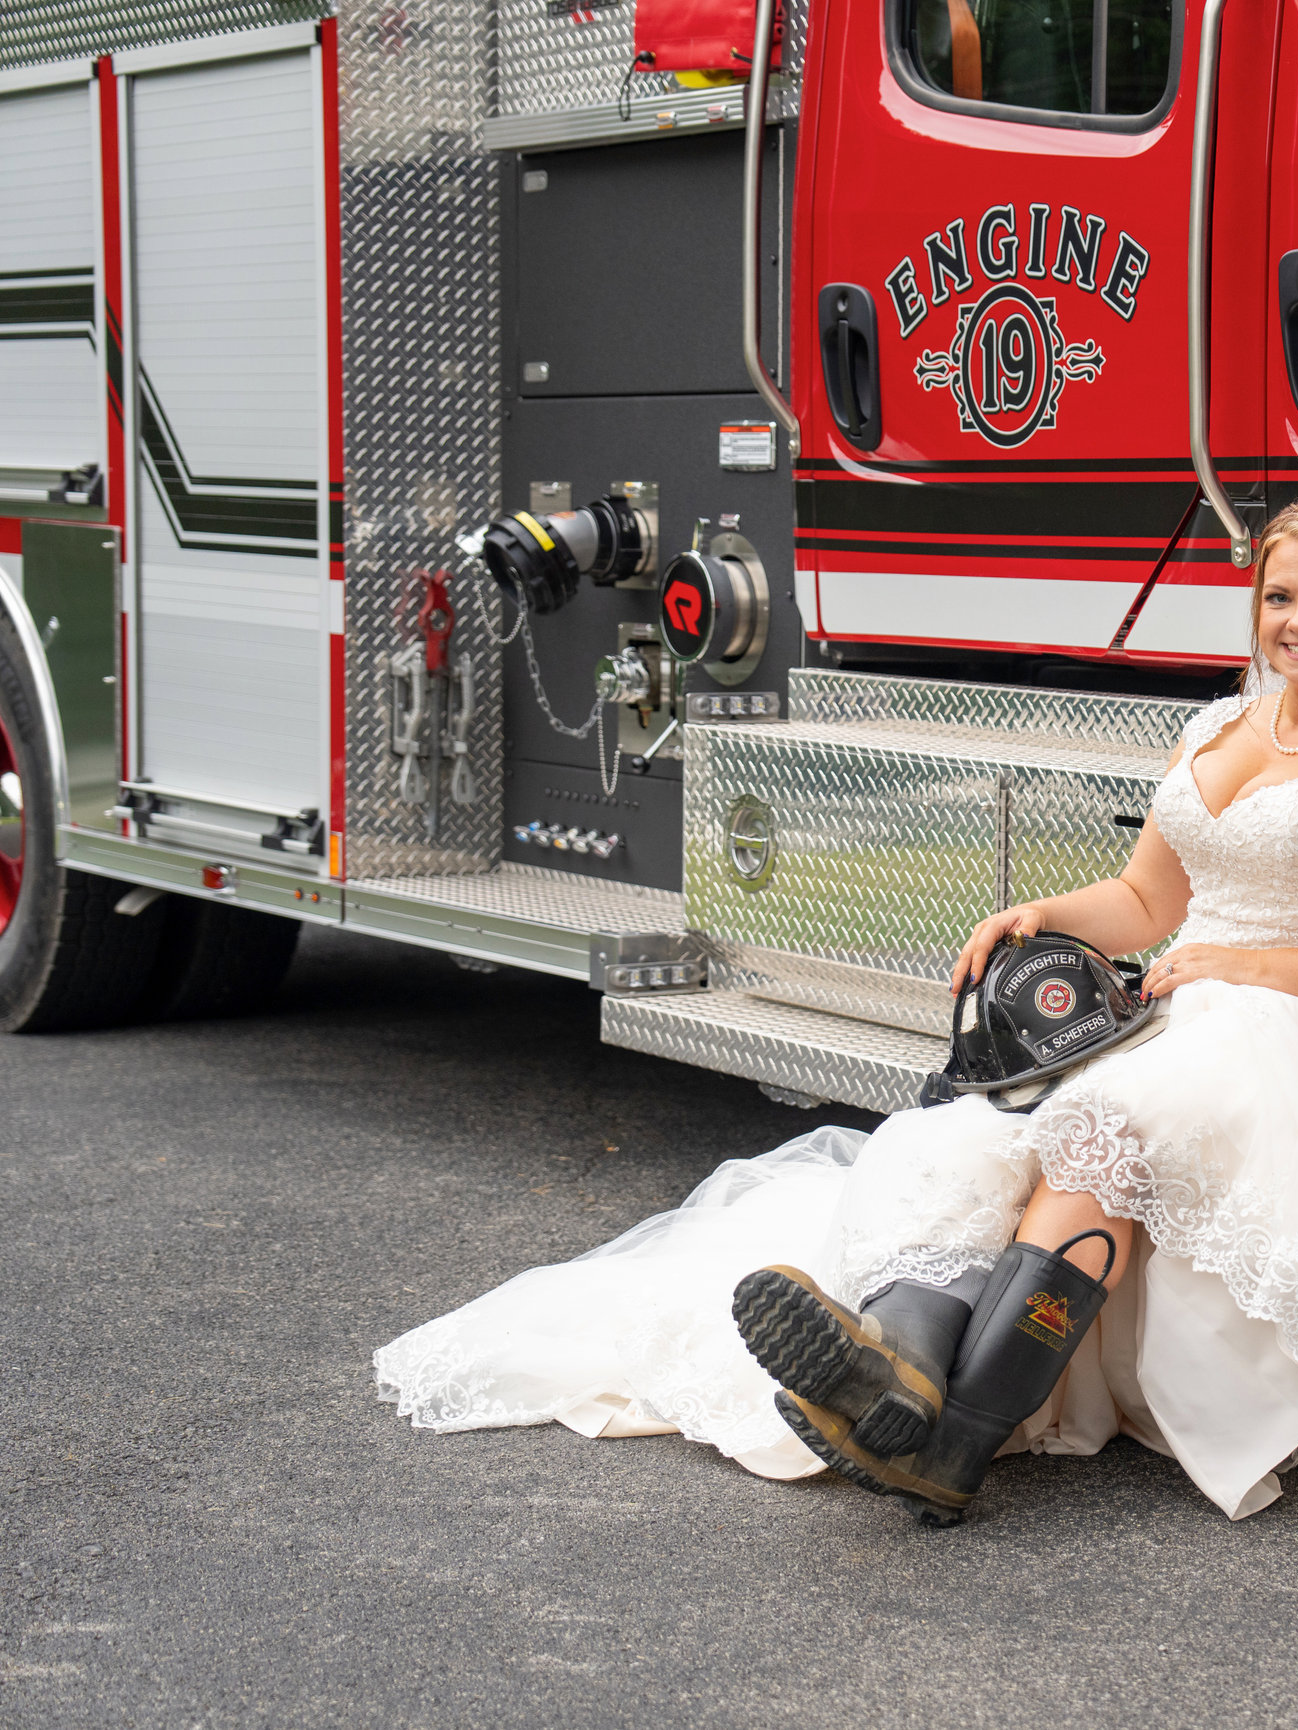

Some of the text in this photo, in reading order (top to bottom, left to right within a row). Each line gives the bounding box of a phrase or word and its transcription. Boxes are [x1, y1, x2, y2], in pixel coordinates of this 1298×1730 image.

[885, 203, 1150, 339] ENGINE
[979, 313, 1036, 412] 19
[1004, 953, 1077, 997] FIREFIGHTER
[1041, 1014, 1107, 1056] A. SCHEFFERS
[1014, 1315, 1067, 1353] HELLFIRE
